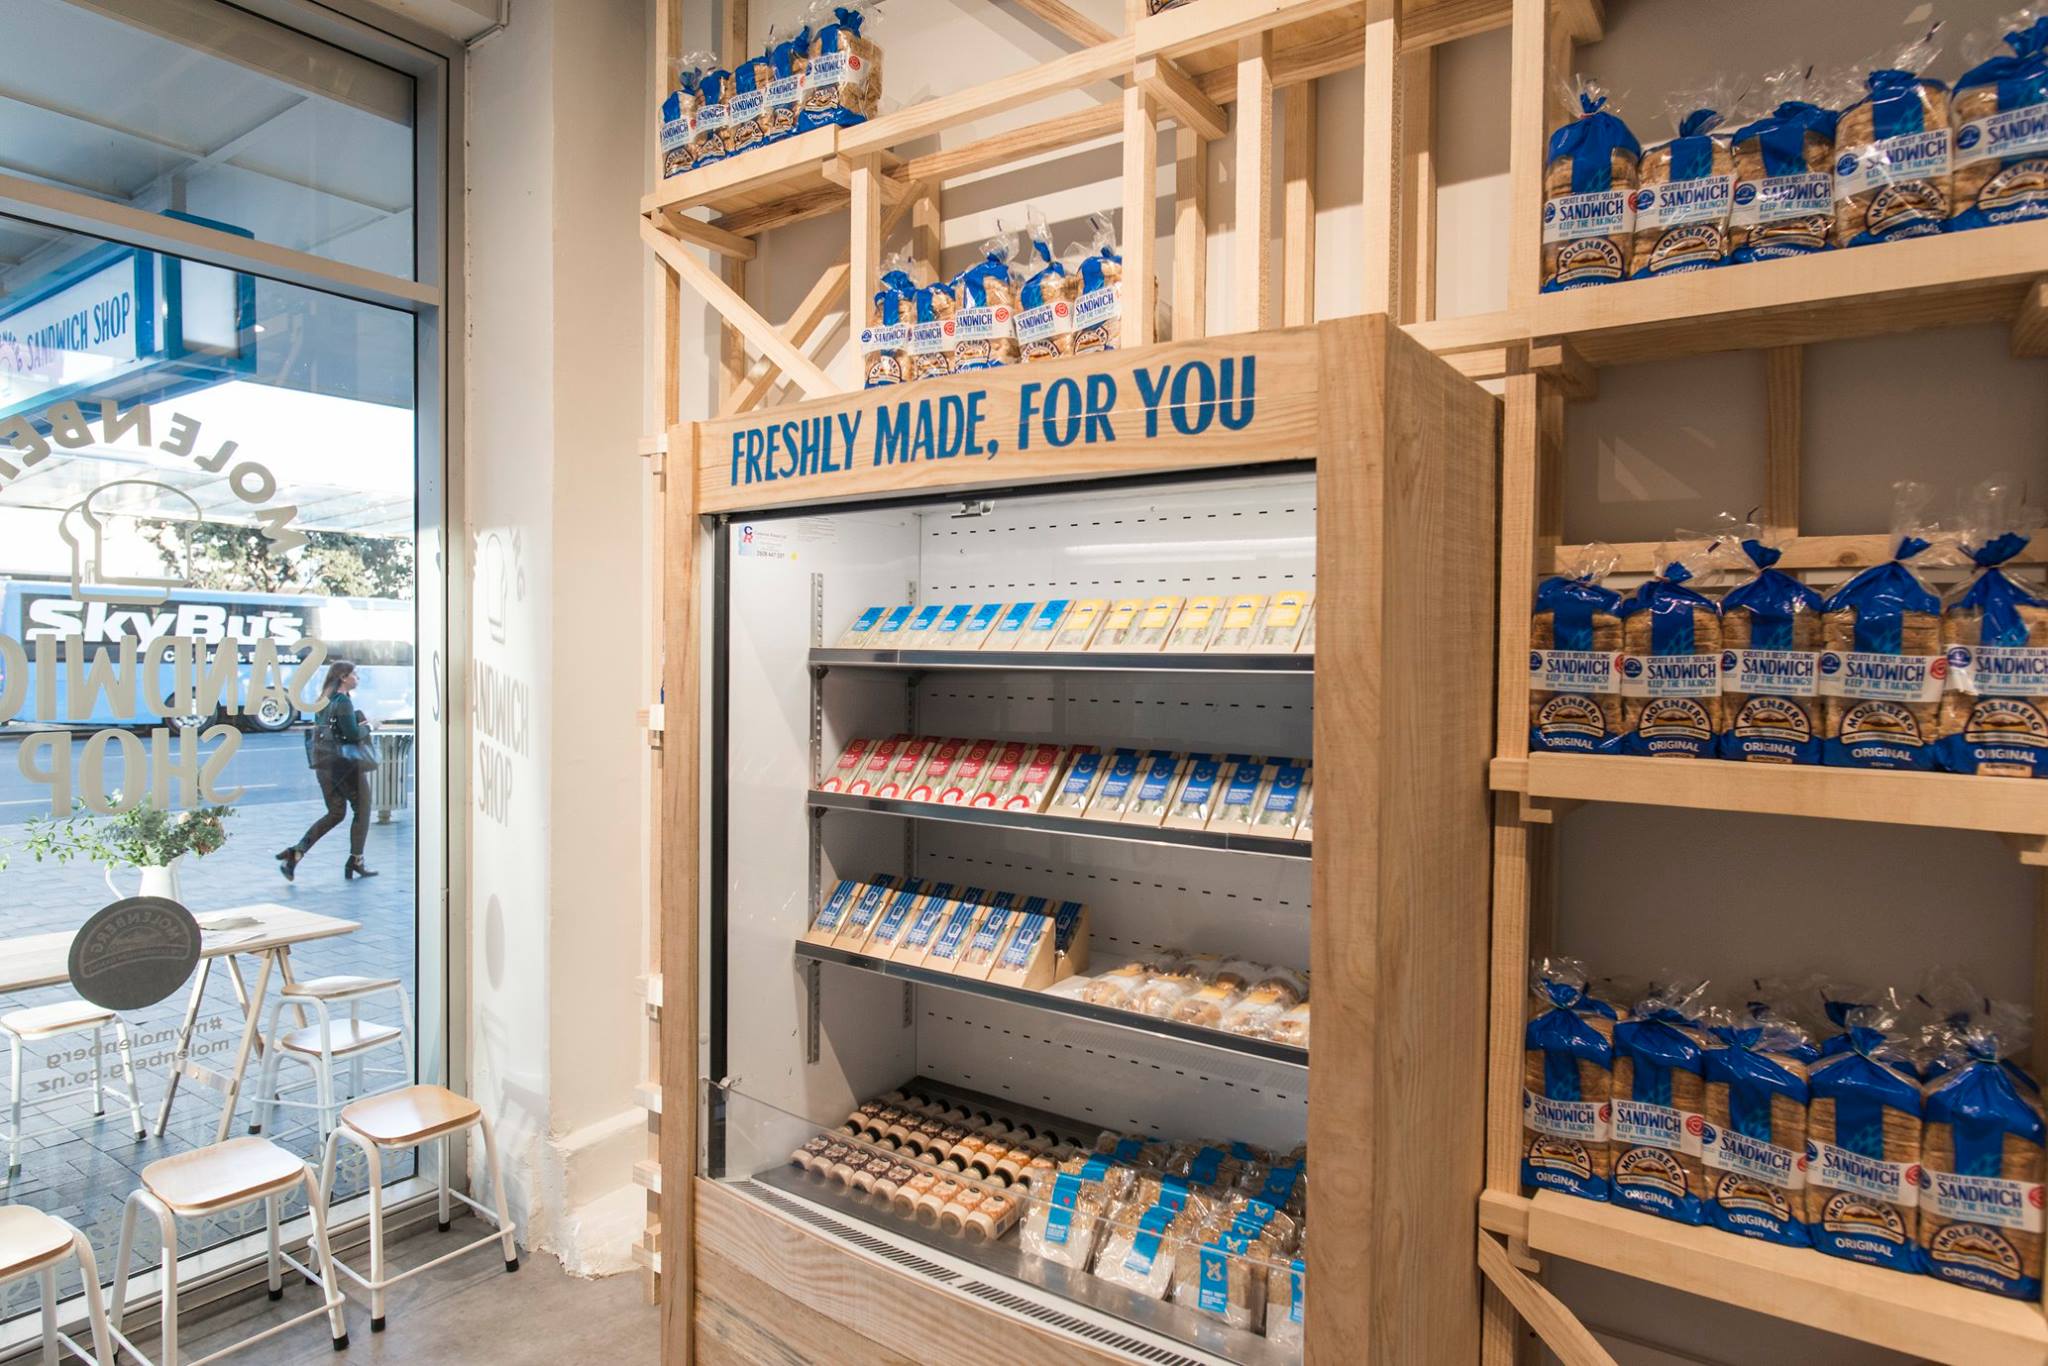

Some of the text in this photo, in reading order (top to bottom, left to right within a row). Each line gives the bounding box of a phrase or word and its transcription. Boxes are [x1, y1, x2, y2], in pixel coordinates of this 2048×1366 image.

[768, 80, 799, 95] SANDWICH
[731, 96, 764, 113] SANDWICH
[662, 123, 689, 139] SANDWICH
[1866, 139, 1946, 170] SNDWICH
[1660, 184, 1728, 208] SANDWICH
[1560, 199, 1624, 221] SANDWICH
[1560, 240, 1618, 268] MOLENBERG
[1075, 293, 1114, 314] SANDWICH
[956, 313, 992, 327] SANDWICH
[1018, 310, 1054, 330] SANDWICH
[27, 309, 88, 371] SANDWICH
[93, 291, 130, 344] SHOP
[874, 328, 906, 343] SANDWICH
[914, 327, 942, 340] SANDWICH
[731, 355, 1256, 486] FRESHLY MADE, FOR YOU
[1546, 659, 1609, 675] SANDWICH
[1647, 664, 1716, 679] SANDWICH
[1742, 659, 1813, 676] SANDWICH
[1846, 662, 1925, 682] SANDWICH
[1543, 697, 1600, 723] MOLENBERG
[1645, 700, 1705, 725] MOLENBERG
[1742, 700, 1804, 727] MOLENBERG
[1848, 703, 1914, 731] MOLENBERG
[1546, 737, 1594, 750] ORIGINAL
[1649, 741, 1700, 752] ORIGINAL
[1743, 742, 1797, 756] ORIGINAL
[1852, 747, 1912, 761] ORIGINAL
[1974, 749, 2038, 763] ORIGINAL
[478, 741, 513, 828] SHOP
[1535, 1102, 1594, 1124] SANDWICH
[1618, 1109, 1681, 1133] SANDWICH
[1721, 1137, 1791, 1171] SANDWICH
[1622, 1150, 1680, 1181] MOLENBERG
[1824, 1153, 1899, 1185] SANDWICH
[1625, 1190, 1674, 1209] ORIGINAL
[1938, 1182, 2022, 1208] SANDWICH
[1728, 1214, 1781, 1234] ORIGINAL
[1835, 1238, 1894, 1258] ORIGINAL
